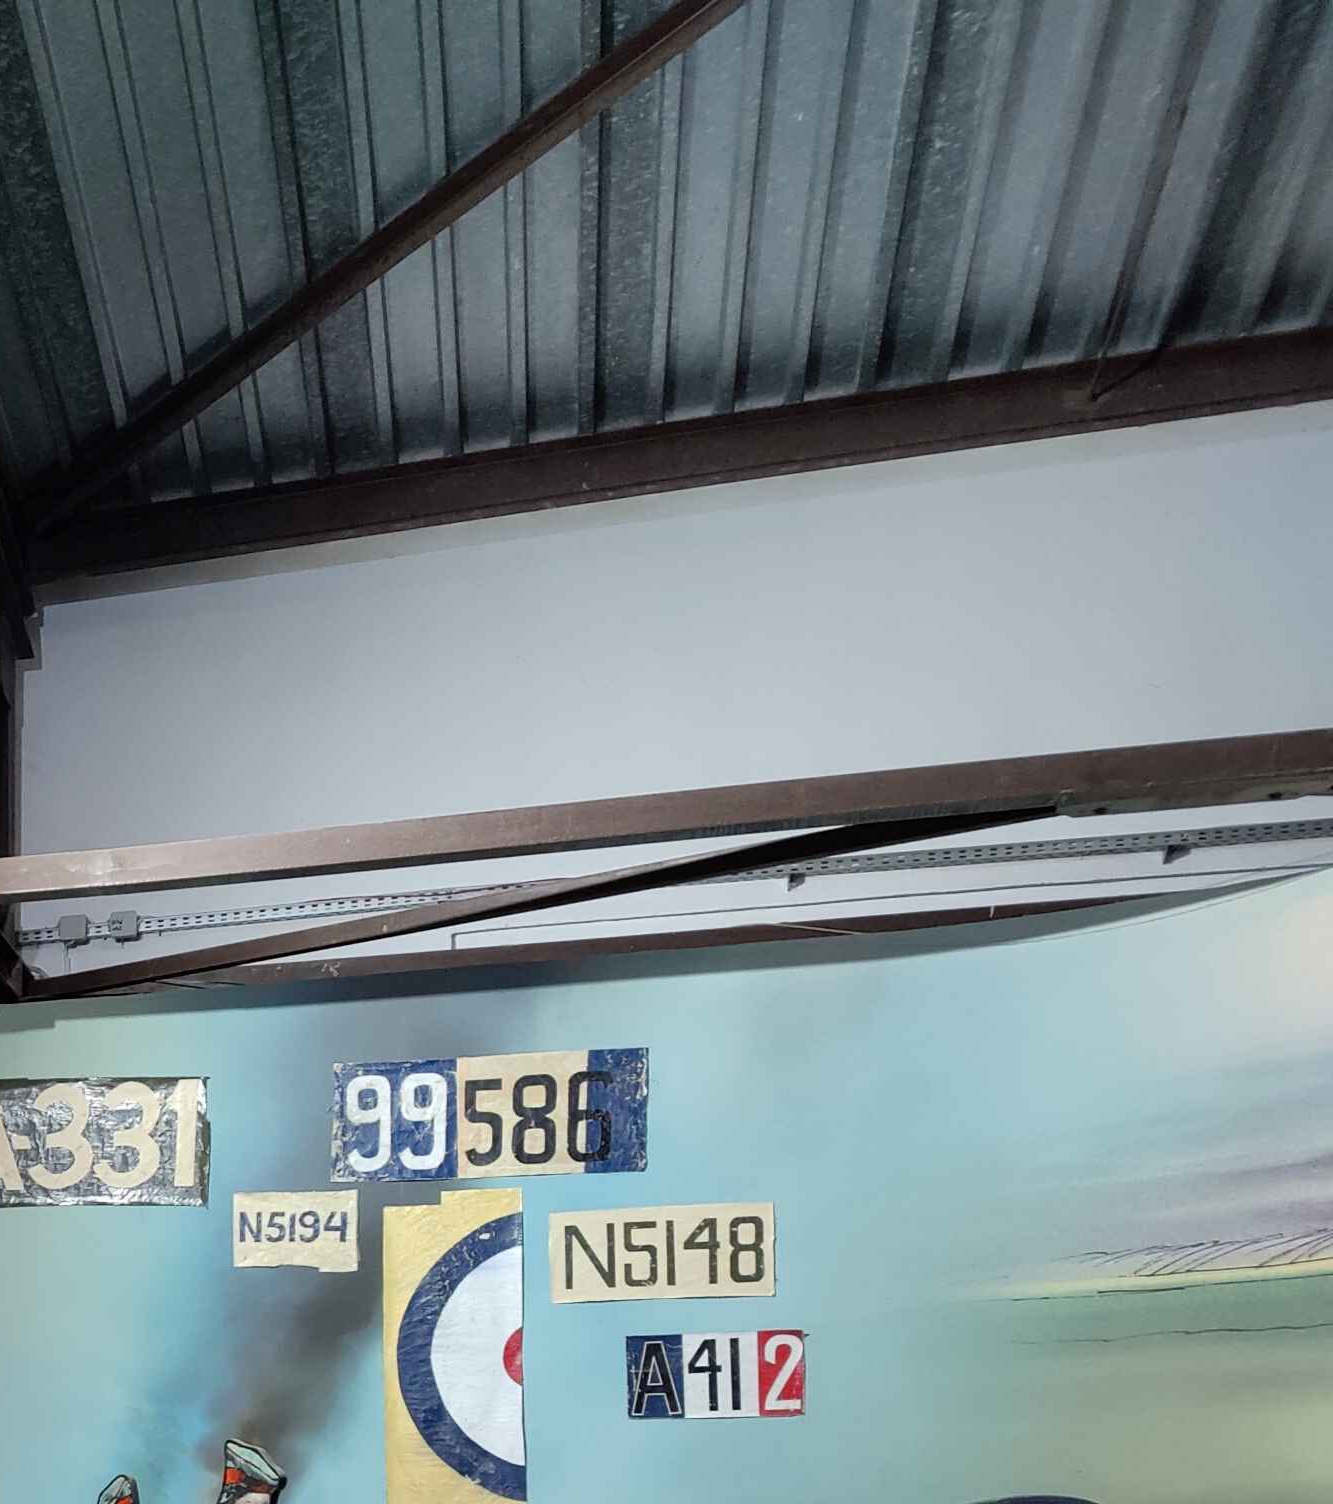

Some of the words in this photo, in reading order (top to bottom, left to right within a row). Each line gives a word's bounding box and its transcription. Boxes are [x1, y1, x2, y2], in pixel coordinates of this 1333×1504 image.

[345, 1070, 613, 1174] 99586
[239, 1209, 349, 1244] N5194
[564, 1214, 765, 1291] N5148
[631, 1333, 805, 1417] A412
